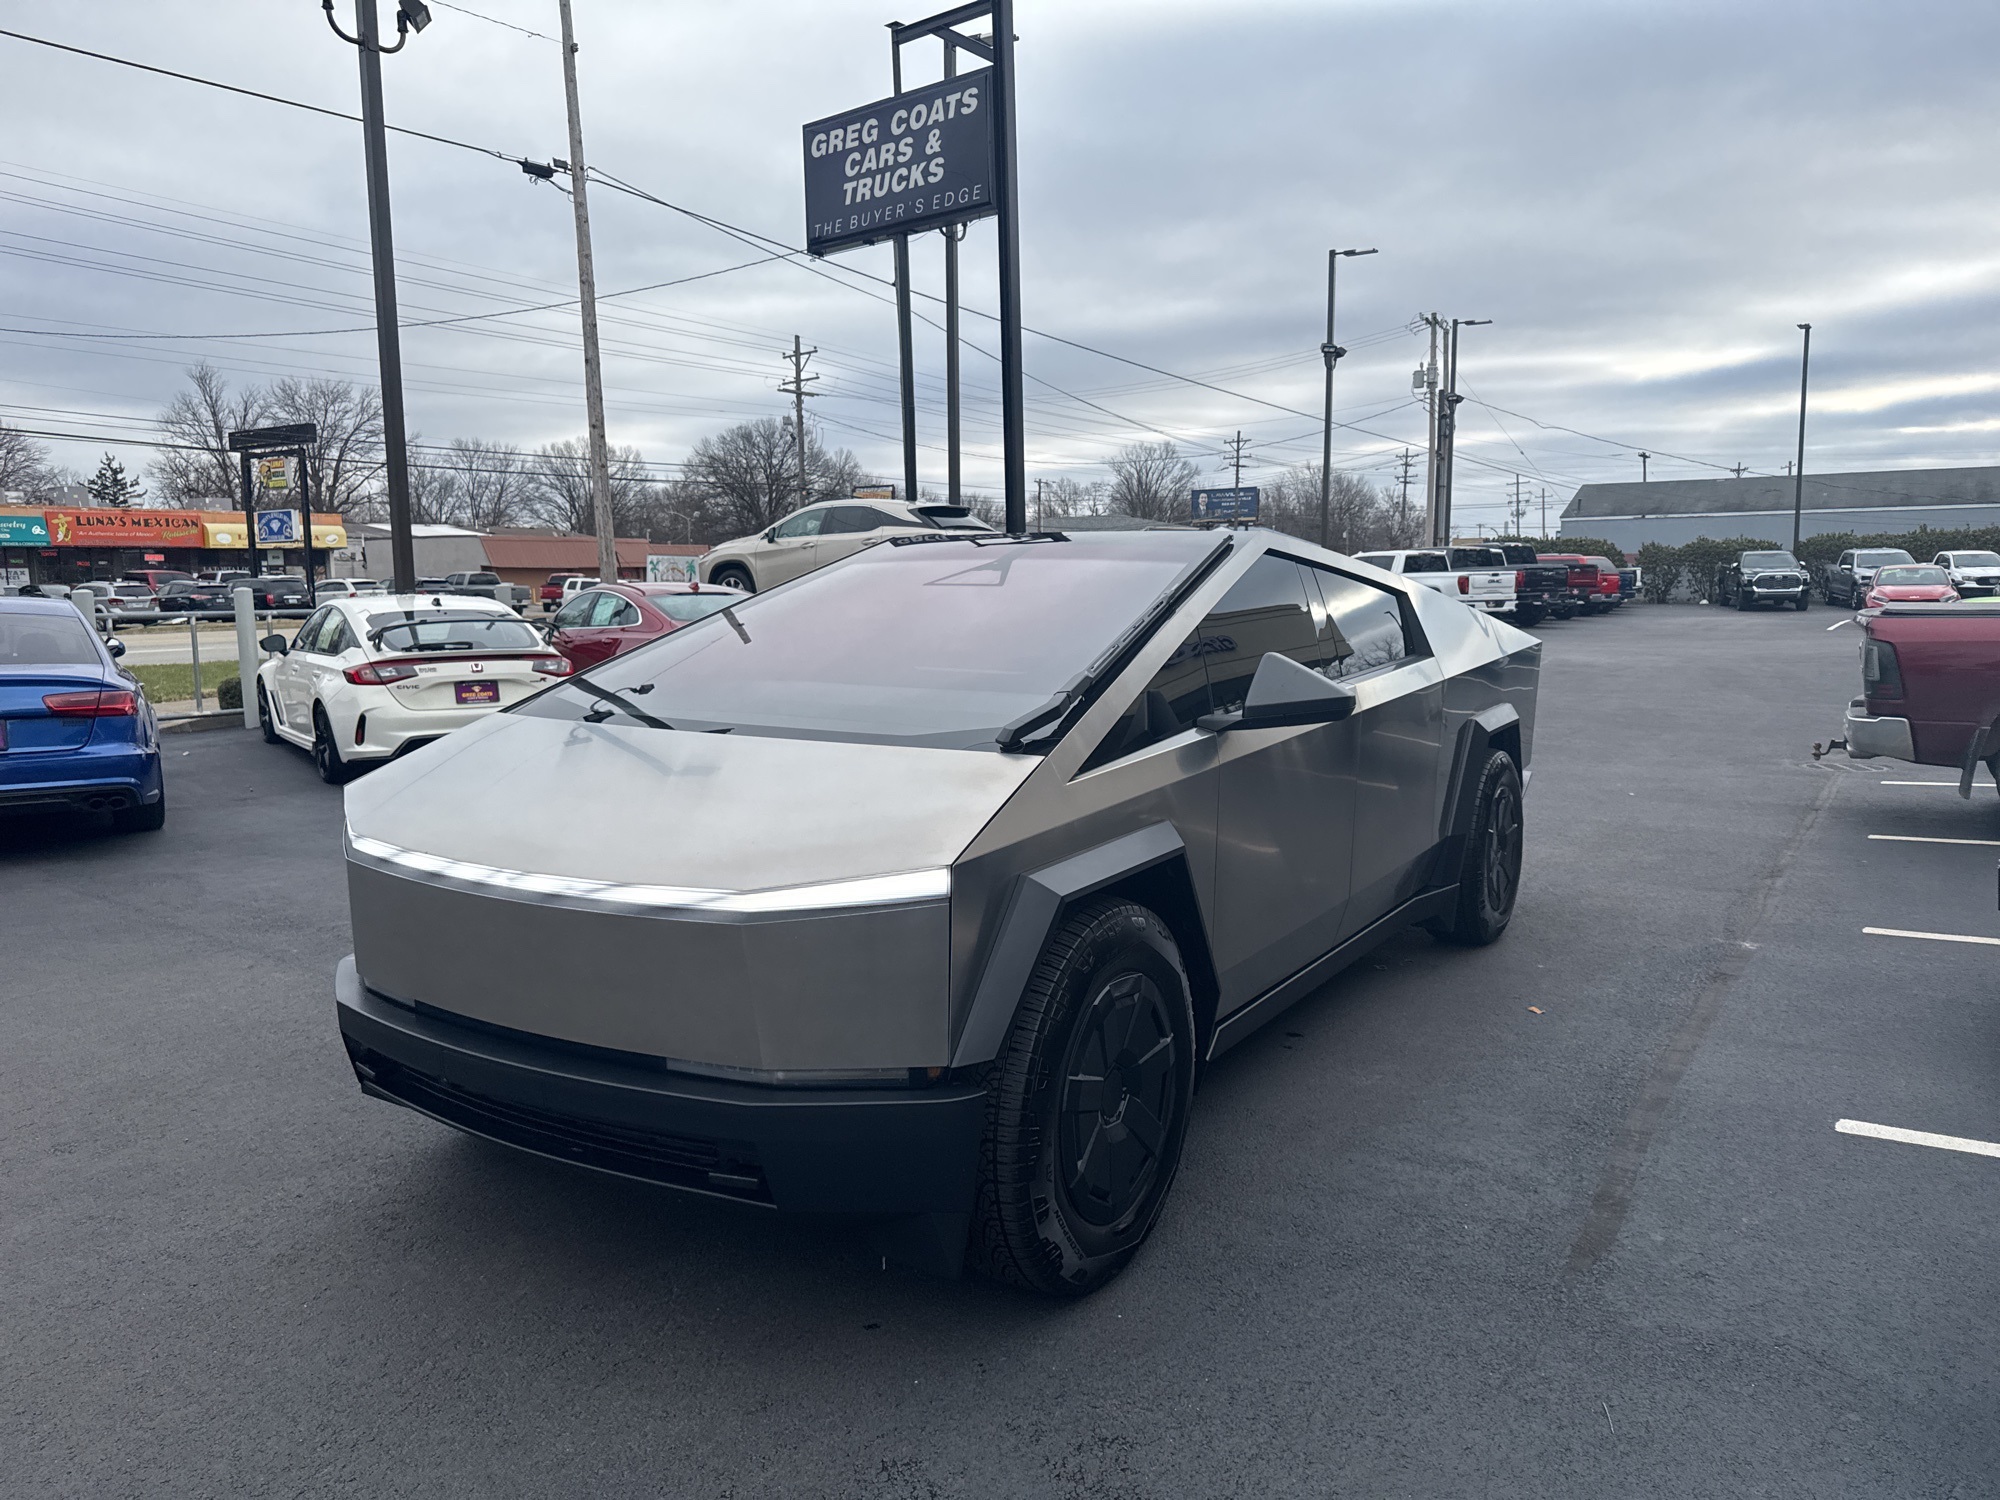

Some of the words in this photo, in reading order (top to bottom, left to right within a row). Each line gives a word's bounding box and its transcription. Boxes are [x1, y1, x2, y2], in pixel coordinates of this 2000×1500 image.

[811, 118, 878, 158] GREG
[890, 87, 979, 136] COATS
[844, 136, 914, 177] CARS
[925, 128, 942, 155] &
[843, 156, 945, 206] TRUCKS
[814, 218, 843, 238] THE
[850, 198, 924, 230] BUYER'S
[932, 184, 982, 210] EDGE
[76, 516, 127, 528] LUNA'S
[131, 517, 199, 529] MEXICAN
[1053, 1209, 1084, 1261] SCORPION
